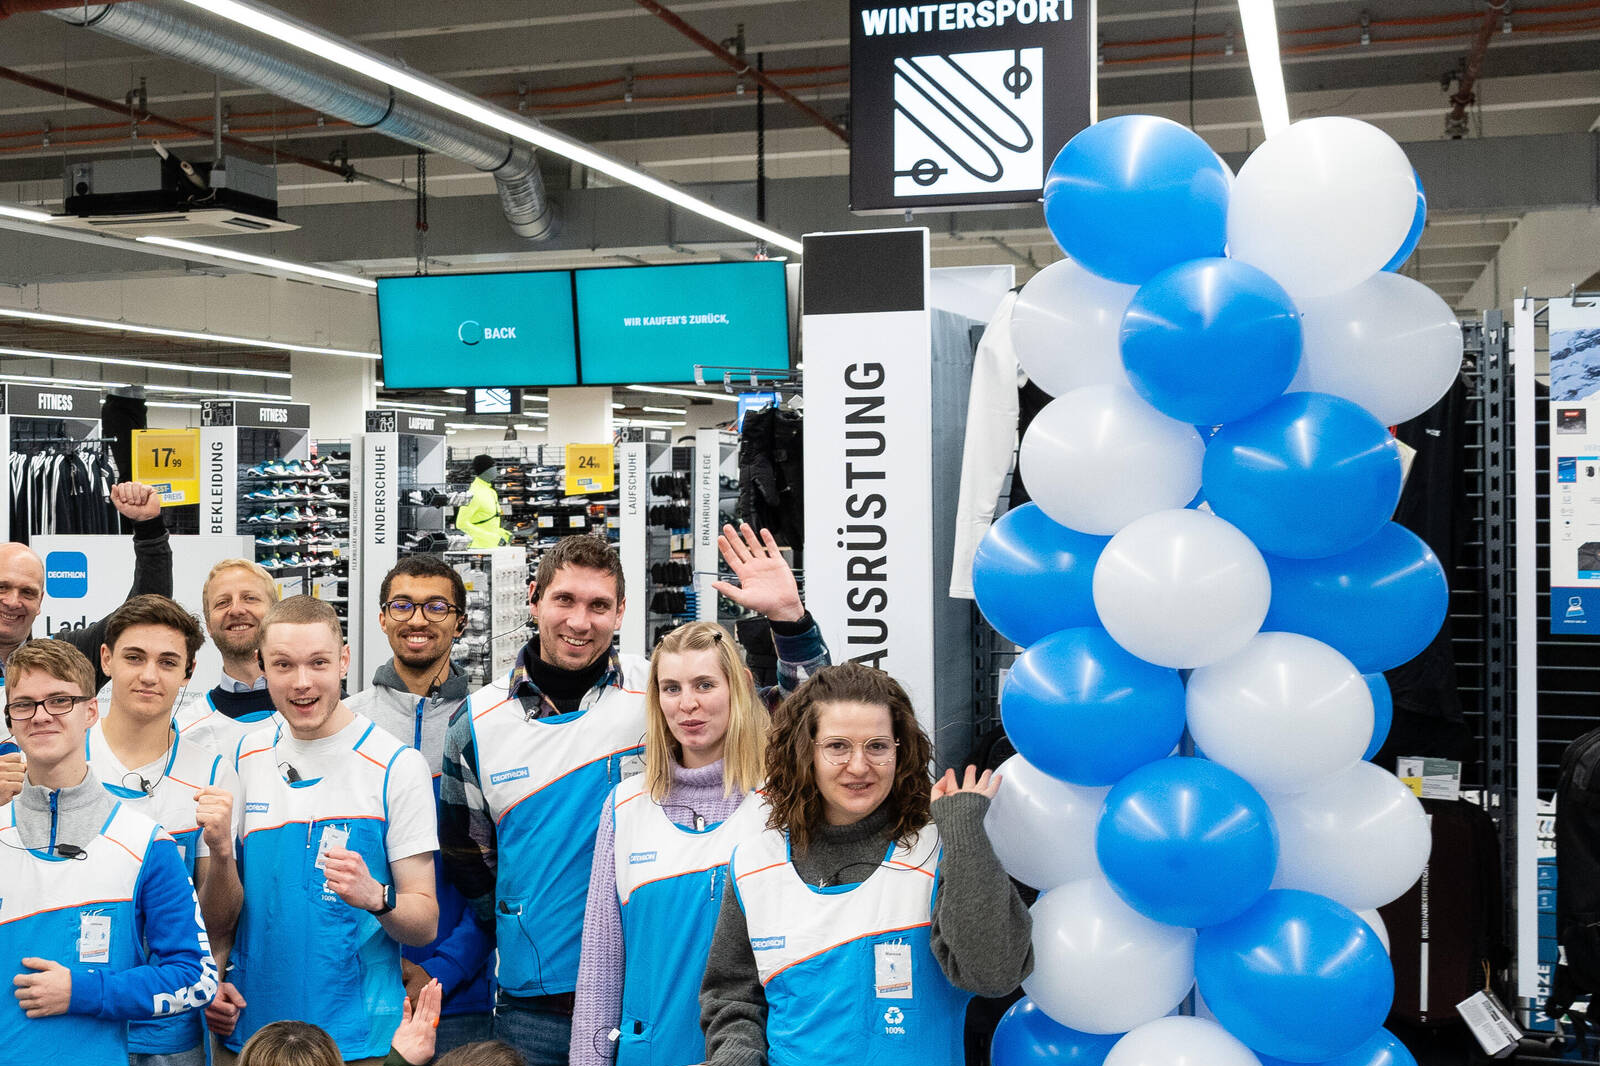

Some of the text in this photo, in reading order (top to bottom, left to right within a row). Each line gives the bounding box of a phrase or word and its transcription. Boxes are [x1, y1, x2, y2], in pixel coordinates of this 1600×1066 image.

[861, 0, 1073, 36] WINTERSPORT
[624, 313, 730, 327] WIR KAUFEN'S ZURÜCK,
[484, 327, 516, 339] BACK
[38, 393, 73, 411] FITNESS
[260, 408, 288, 423] FITNESS
[703, 454, 712, 484] PFLEGE
[211, 441, 223, 534] BEKLEIDUNG
[629, 452, 637, 515] LAUFSCHUHE
[375, 445, 386, 545] KINDERSCHUHE
[48, 571, 85, 579] DECATHLON
[46, 616, 97, 636] Lad
[492, 768, 528, 784] DECATHLON
[885, 1027, 906, 1035] 100%
